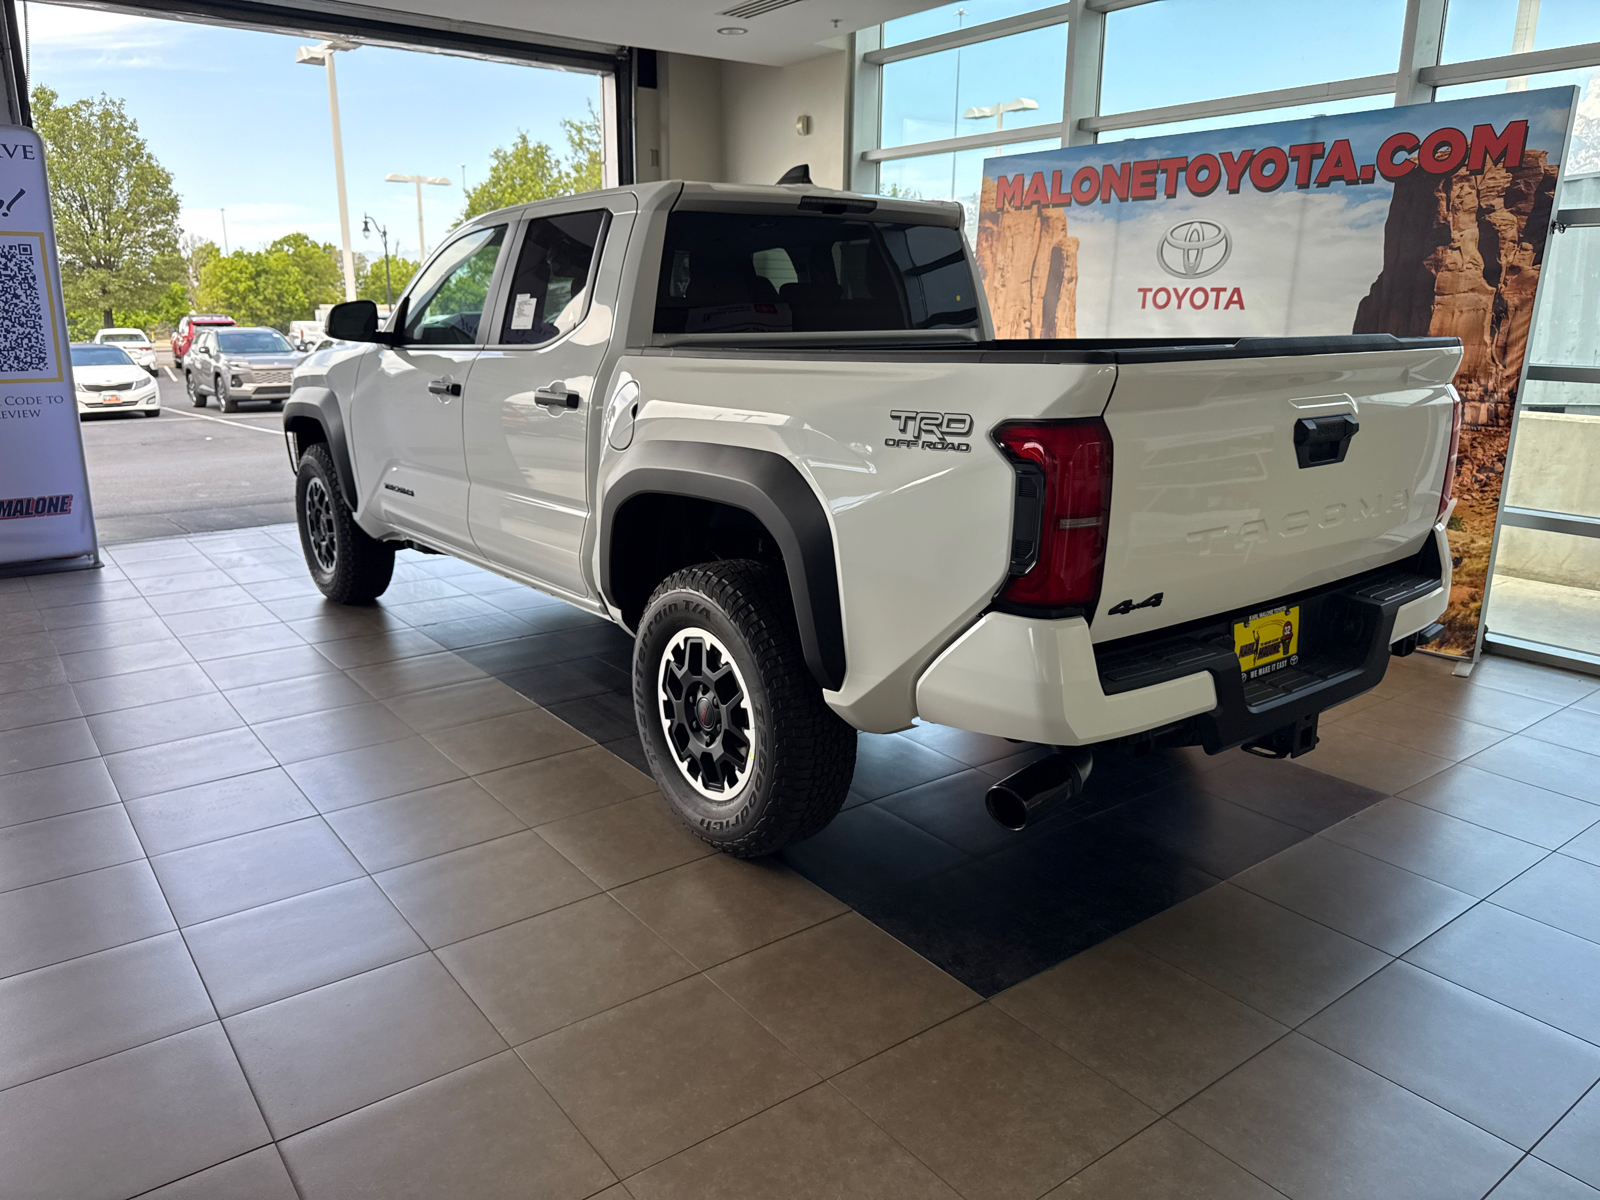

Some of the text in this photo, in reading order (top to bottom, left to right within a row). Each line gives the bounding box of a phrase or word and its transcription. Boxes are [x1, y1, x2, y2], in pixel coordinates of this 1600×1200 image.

[0, 143, 35, 160] VE
[995, 119, 1529, 211] MALONETOYOTA.COM
[1137, 286, 1246, 311] TOYOTA
[4, 395, 64, 406] CODE TO
[0, 409, 41, 419] EVIEW
[890, 409, 974, 443] TRD
[884, 438, 972, 453] OFF ROAD
[0, 494, 73, 520] MALONE
[1187, 487, 1411, 556] TACOMA
[683, 600, 712, 622] T/A
[1284, 625, 1291, 635] 32
[1250, 669, 1258, 679] WE
[1258, 665, 1271, 676] MAKE
[1276, 659, 1288, 670] EASY
